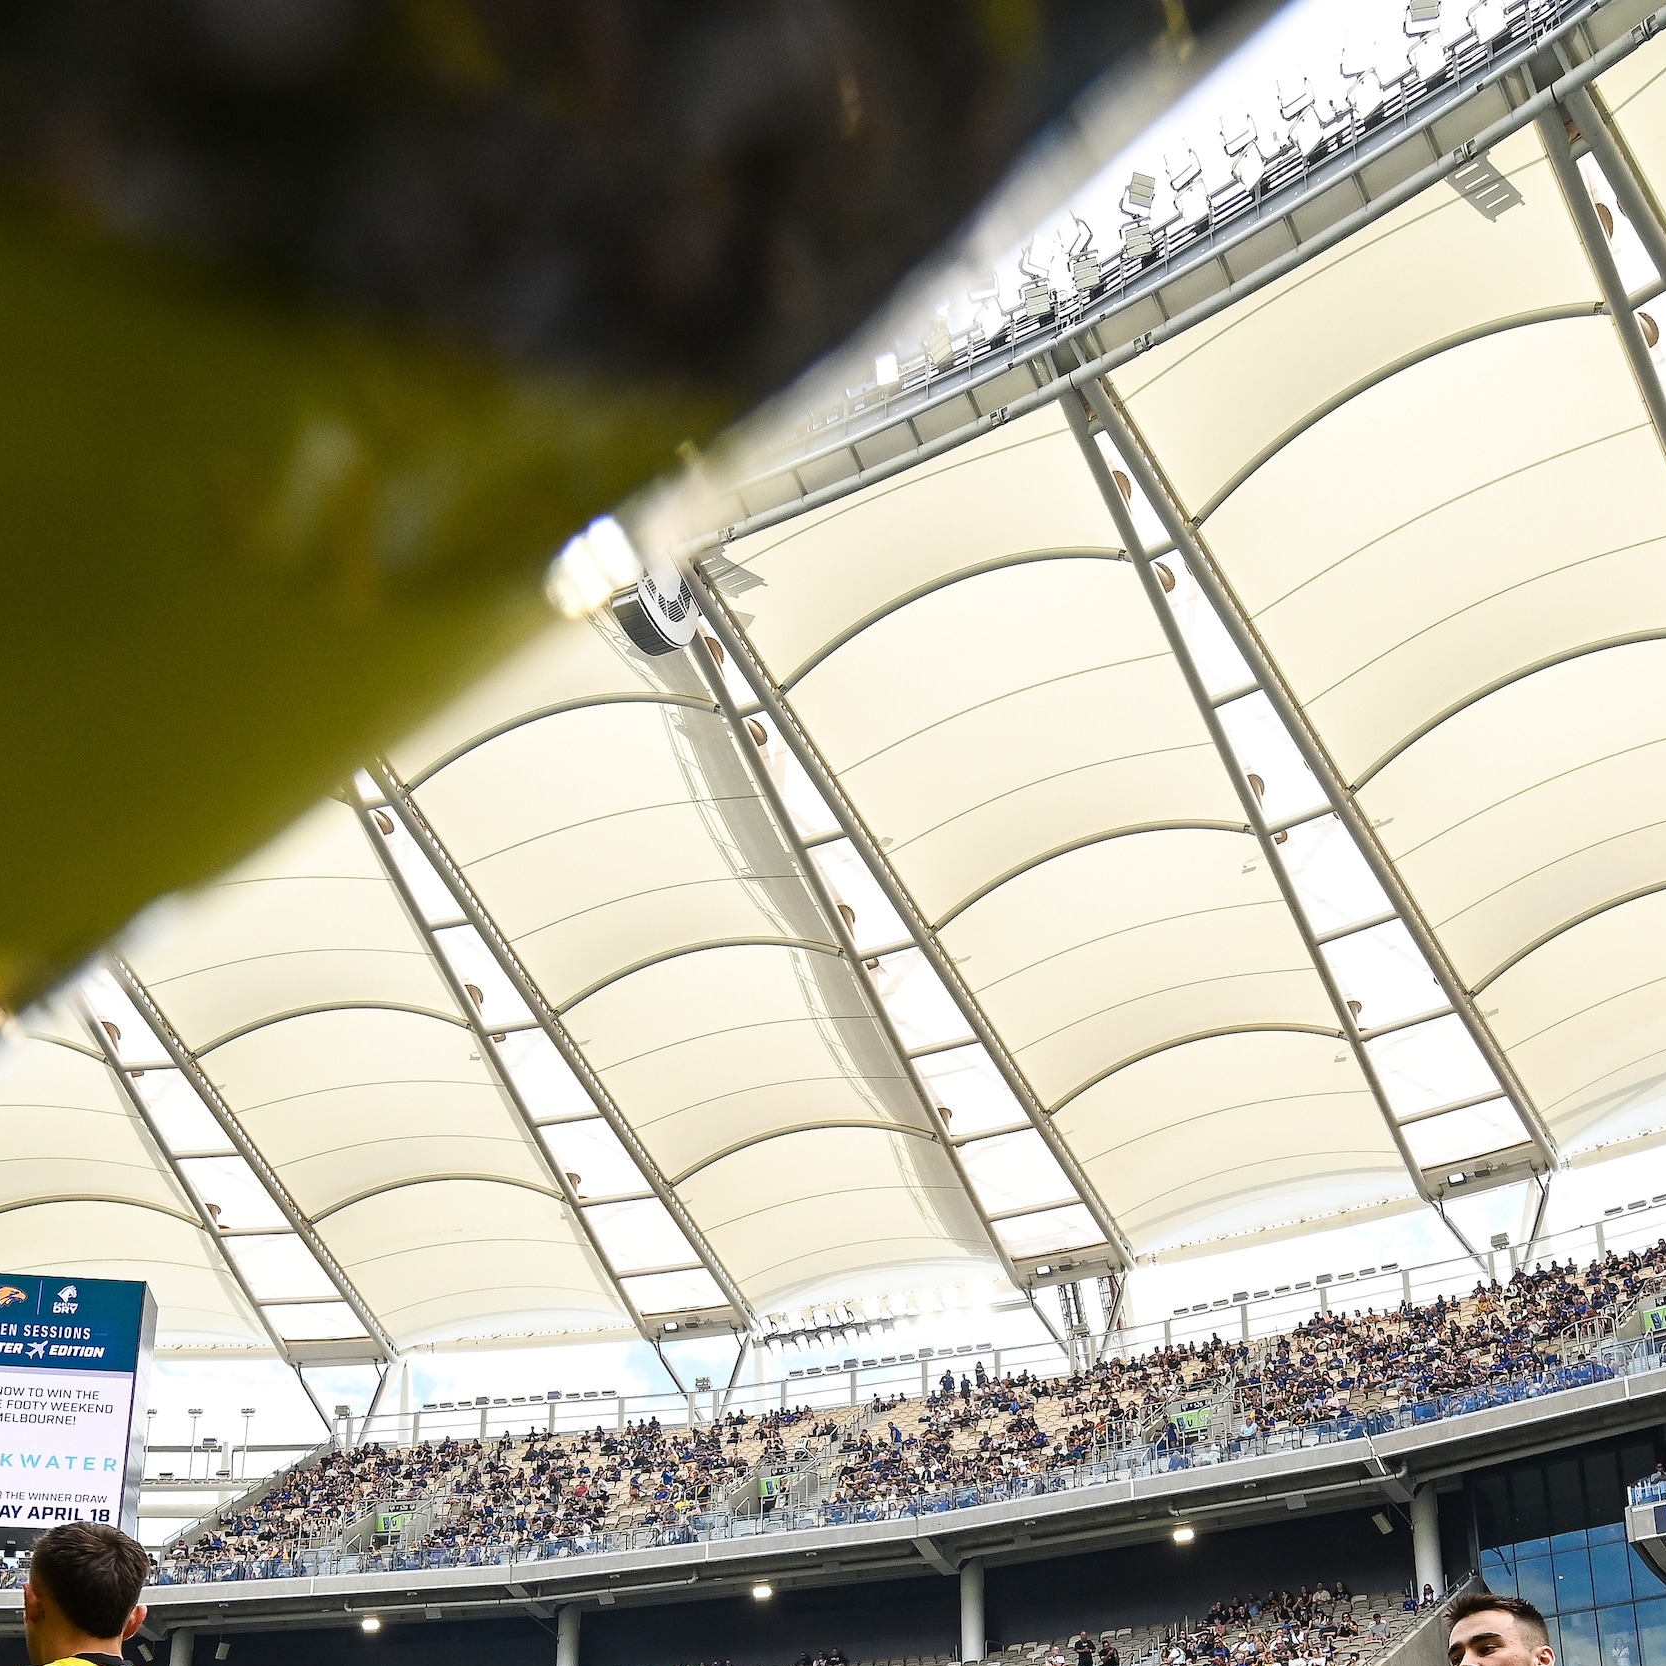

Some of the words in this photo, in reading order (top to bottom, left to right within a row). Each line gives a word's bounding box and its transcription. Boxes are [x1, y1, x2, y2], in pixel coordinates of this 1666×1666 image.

[53, 1304, 78, 1314] DRY
[23, 1324, 92, 1340] SESSIONS
[48, 1344, 105, 1358] EDITION
[28, 1387, 43, 1397] TO
[47, 1388, 72, 1399] WIN
[76, 1390, 100, 1400] THE
[6, 1399, 48, 1411] FOOTY
[50, 1401, 113, 1414] WEEKEND
[6, 1491, 26, 1500] THE
[28, 1492, 72, 1503] WINNER
[74, 1494, 108, 1504] DRAW
[27, 1505, 83, 1521] APRIL
[91, 1509, 110, 1522] 18
